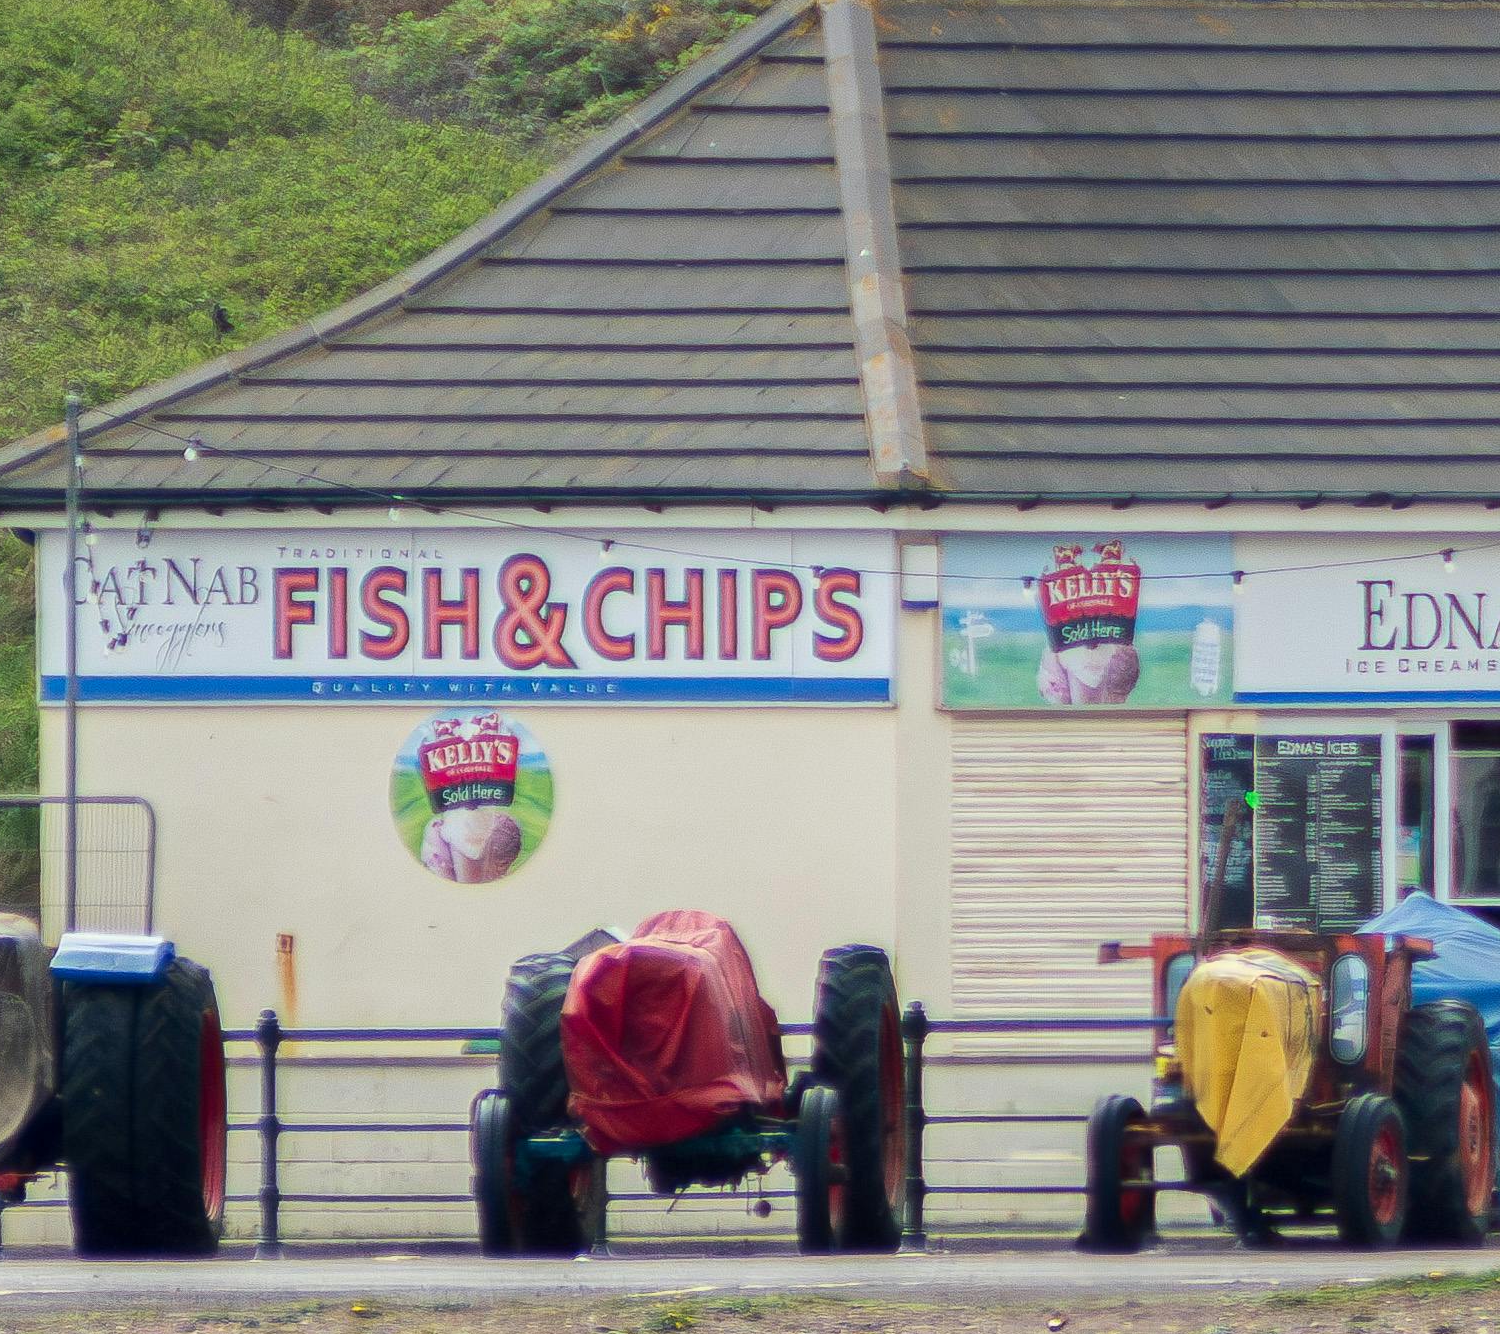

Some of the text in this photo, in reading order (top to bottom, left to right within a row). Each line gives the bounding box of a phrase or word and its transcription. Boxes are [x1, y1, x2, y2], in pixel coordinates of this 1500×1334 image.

[277, 546, 443, 559] TRADITIONAL
[62, 555, 260, 606] CAT NAB
[1045, 570, 1134, 606] KELLY'S
[1061, 620, 1125, 645] Sold Here
[1345, 658, 1387, 673] ICE
[311, 680, 617, 694] QUALITY WITH VALUE
[425, 738, 514, 773] KELLY'S
[1277, 740, 1360, 755] EDNA'S ICES
[442, 782, 504, 806] Sold Here
